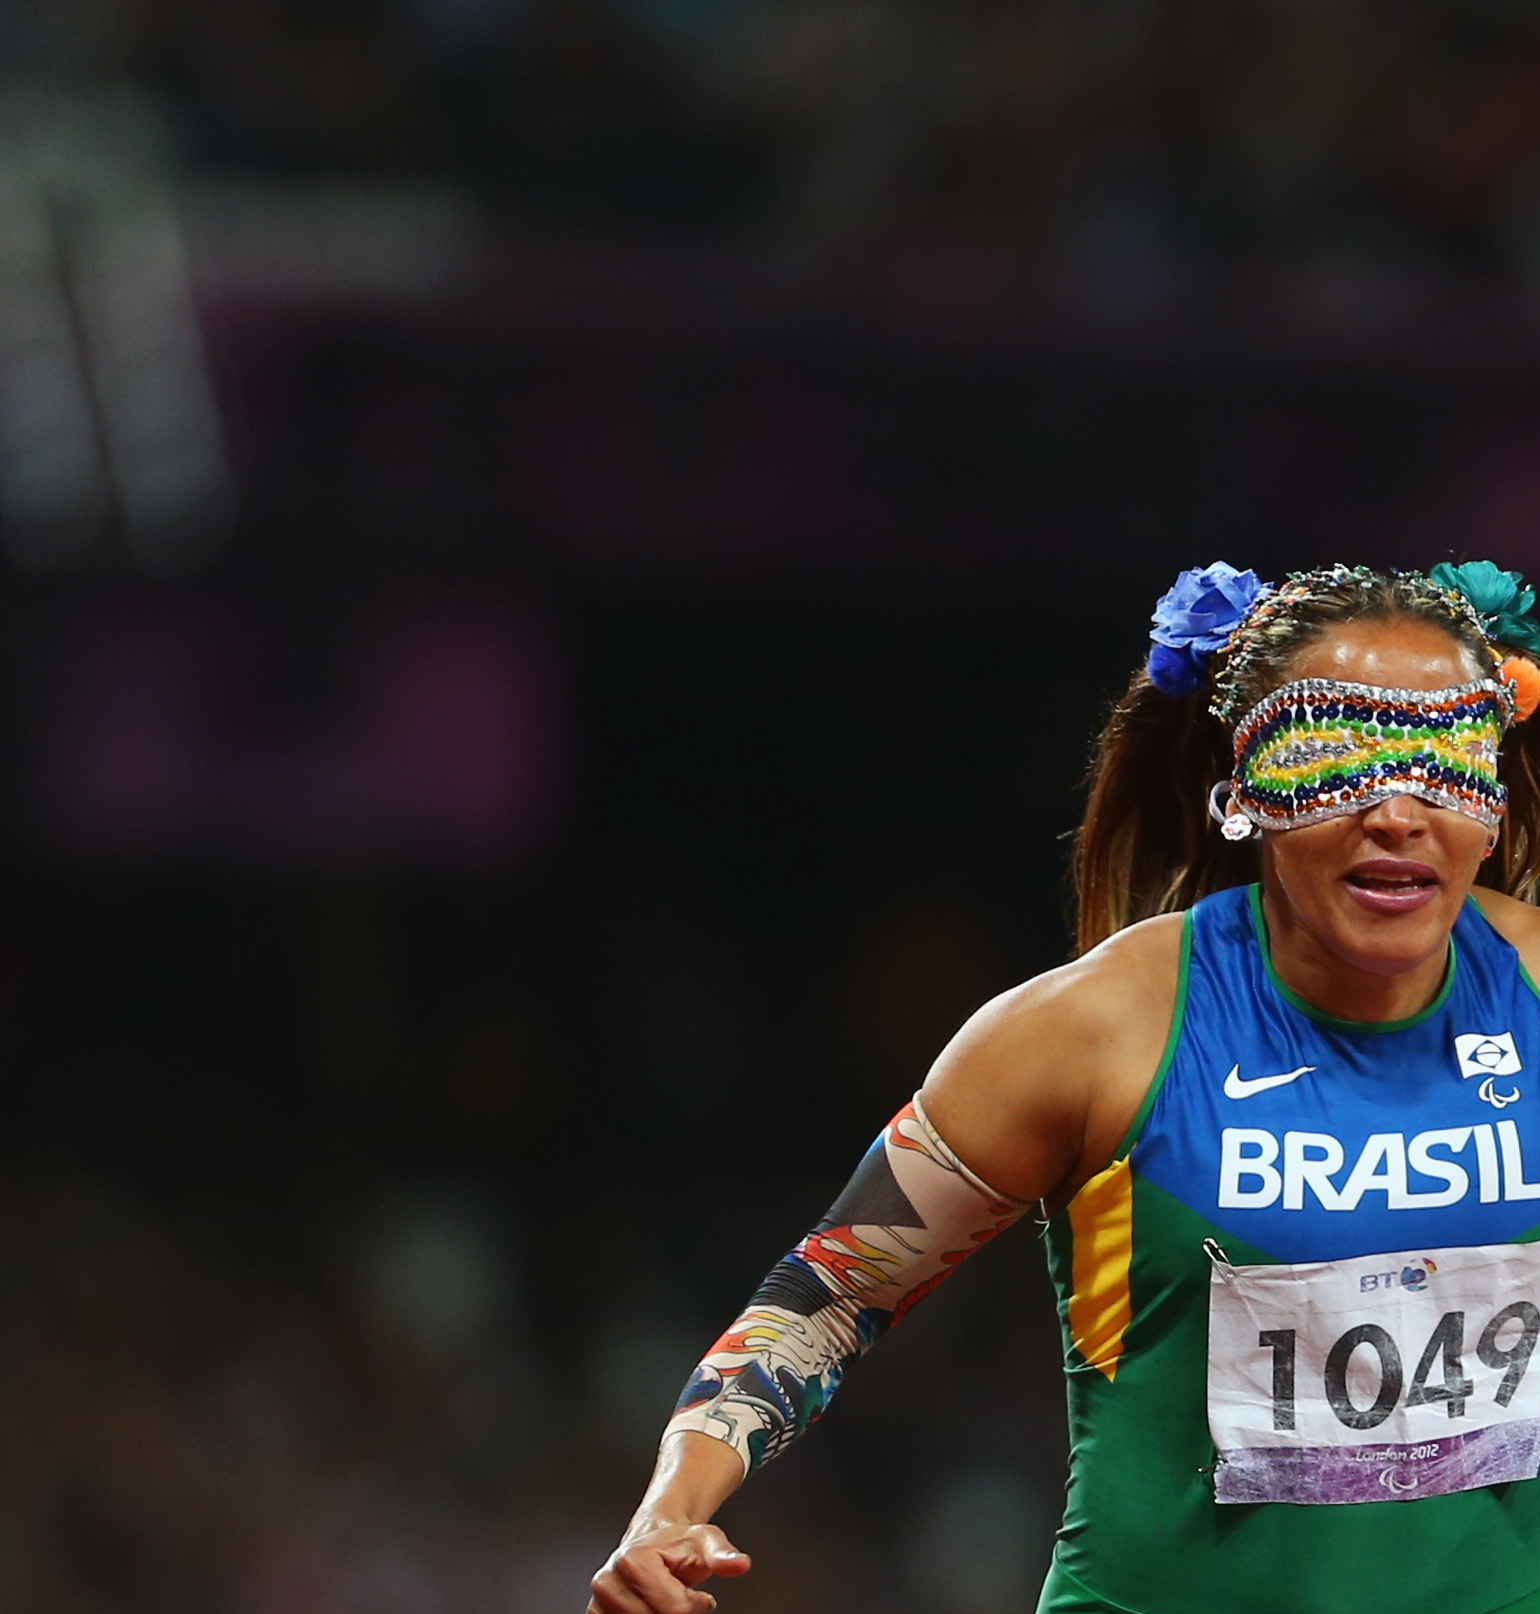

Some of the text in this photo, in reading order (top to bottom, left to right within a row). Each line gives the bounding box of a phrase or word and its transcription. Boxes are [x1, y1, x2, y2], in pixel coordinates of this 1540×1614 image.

[1360, 1271, 1398, 1293] BT
[1355, 1443, 1440, 1462] London 2012
